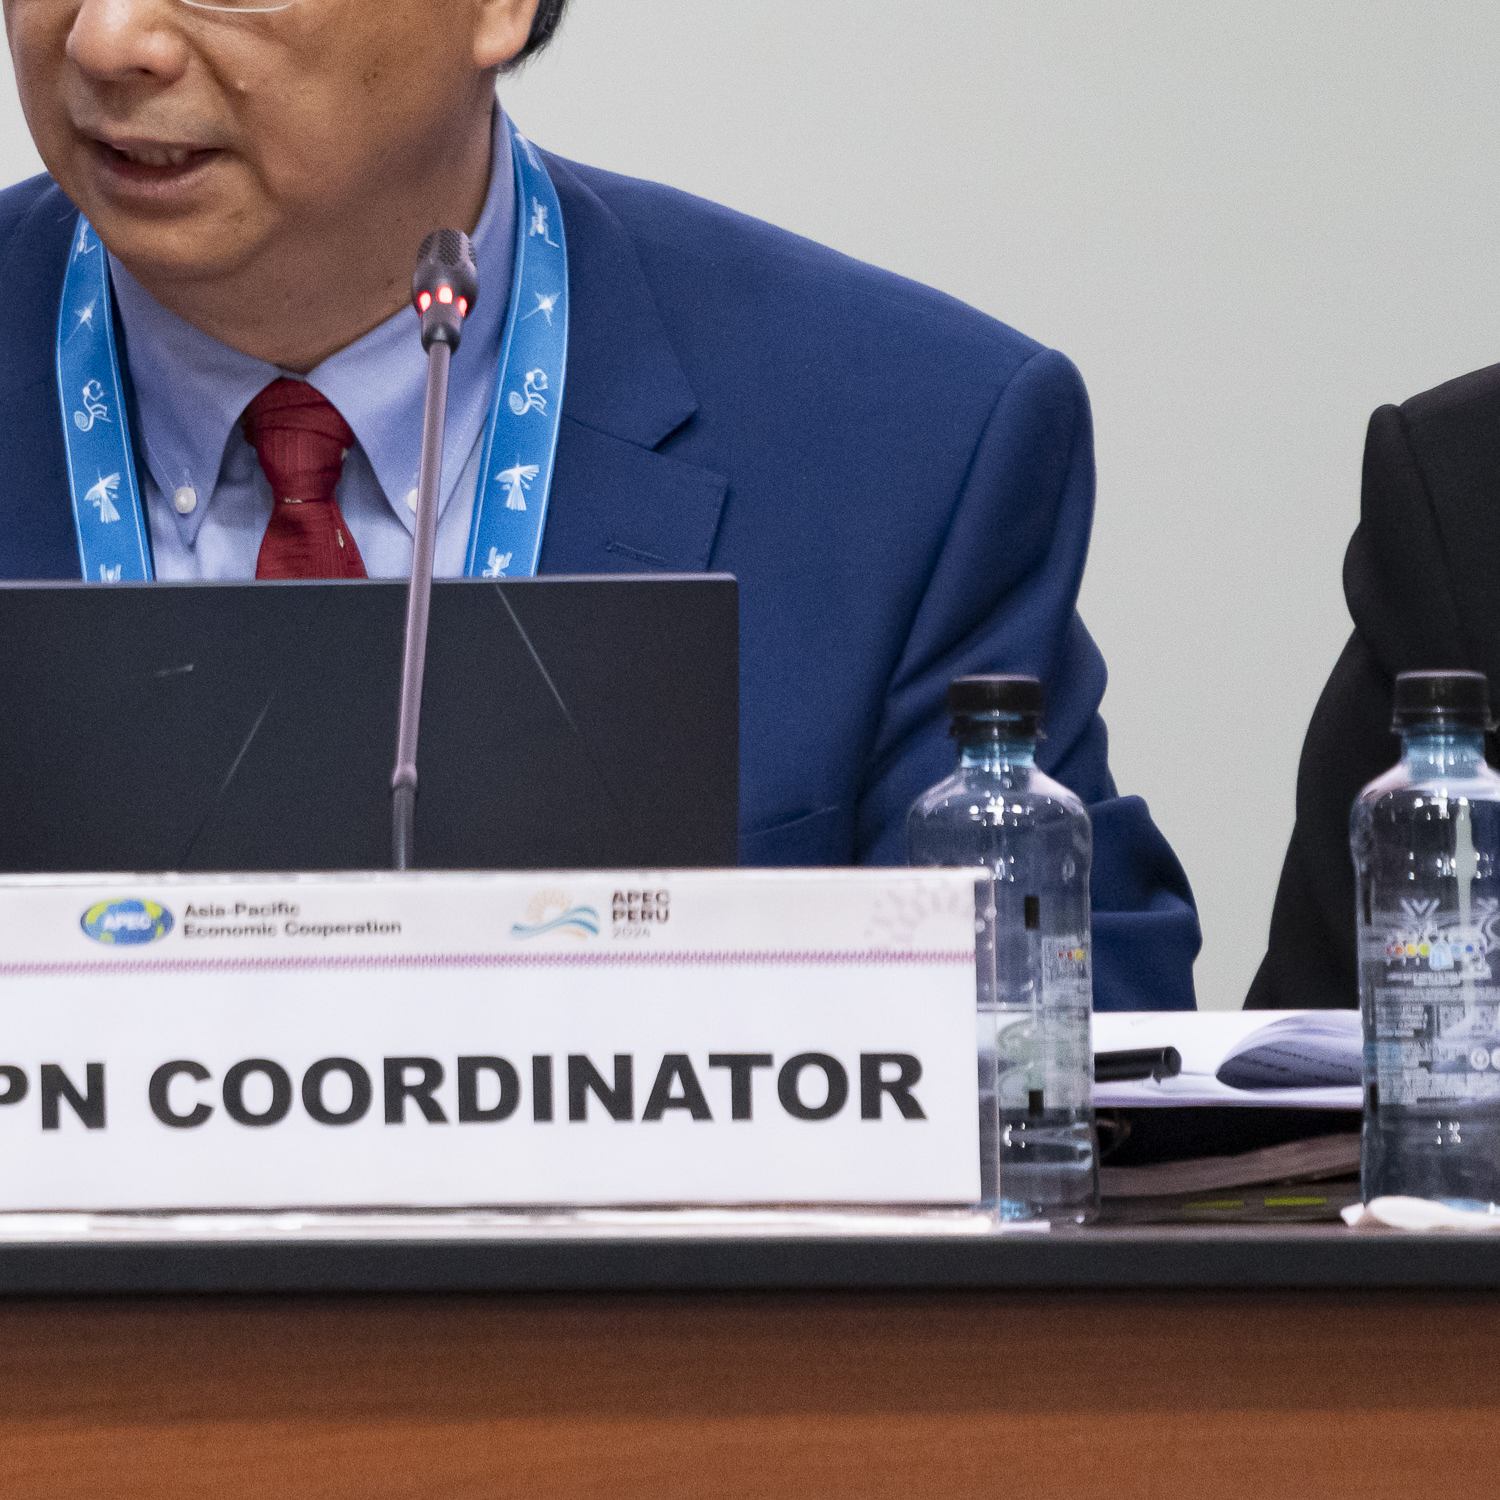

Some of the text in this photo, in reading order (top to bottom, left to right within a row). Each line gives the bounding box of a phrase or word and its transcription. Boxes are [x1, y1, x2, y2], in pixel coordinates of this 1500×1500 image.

[612, 890, 670, 906] APEC
[184, 902, 300, 919] Asia-Pacific
[103, 911, 152, 931] APEC
[183, 921, 403, 940] Economic Cooperation
[149, 1053, 928, 1130] COORDINATOR
